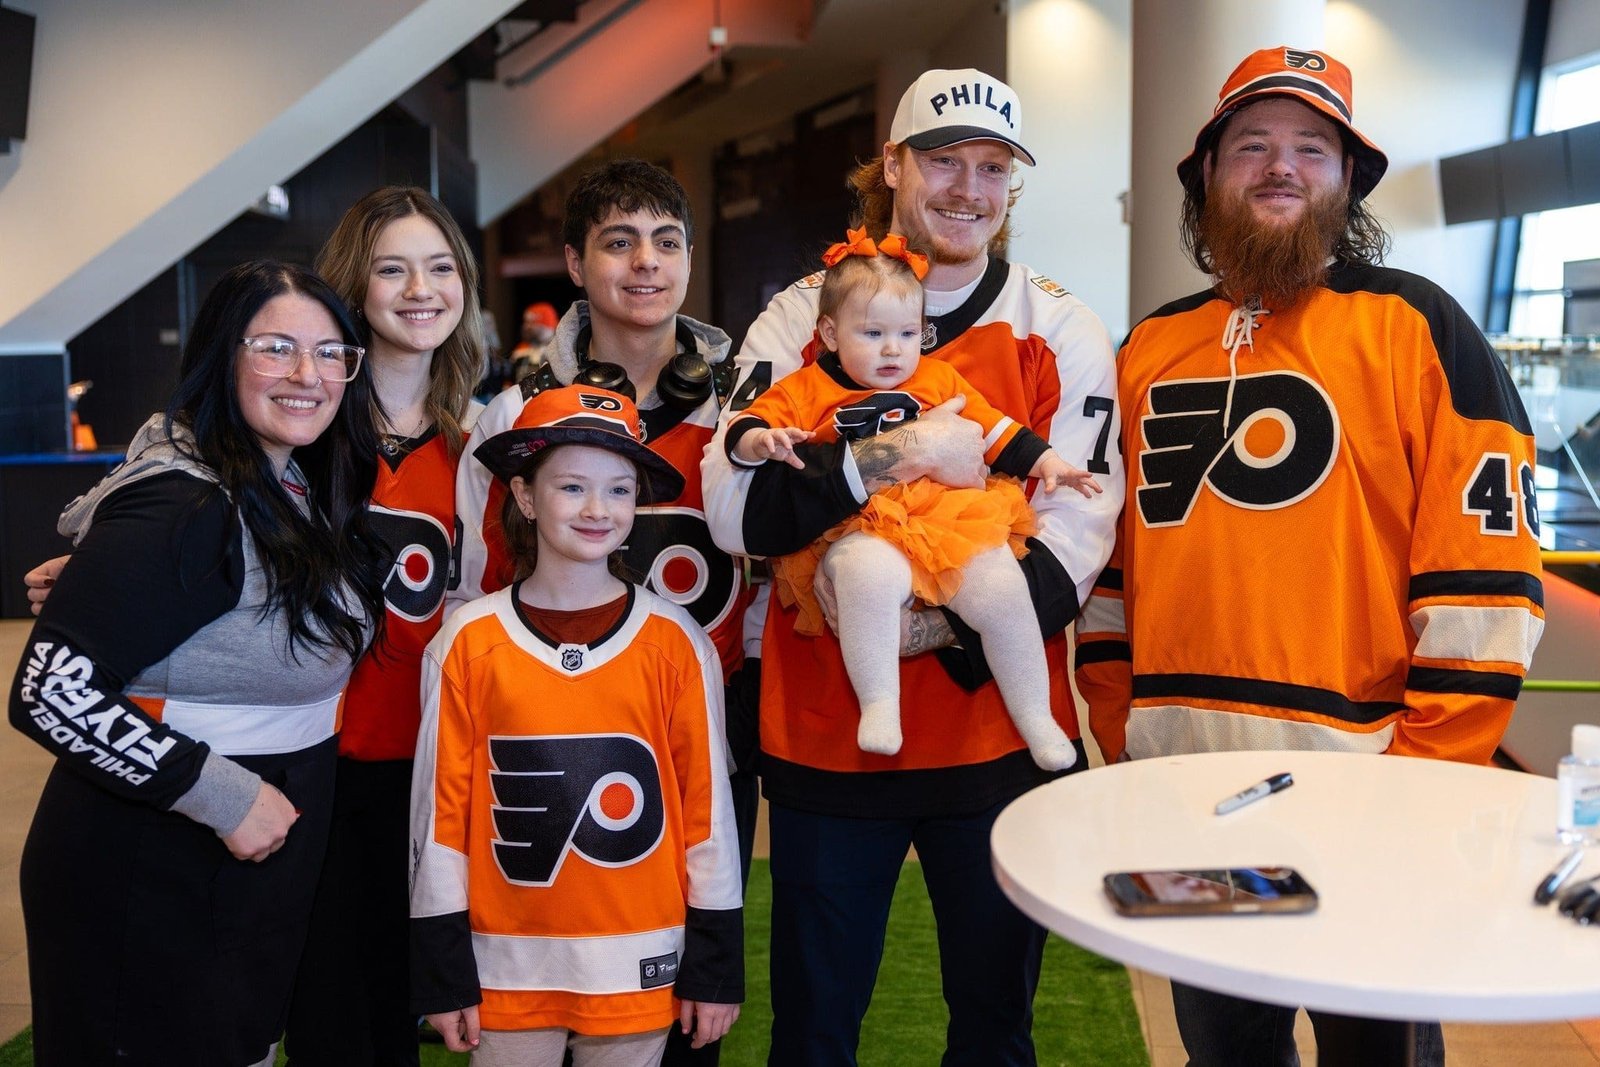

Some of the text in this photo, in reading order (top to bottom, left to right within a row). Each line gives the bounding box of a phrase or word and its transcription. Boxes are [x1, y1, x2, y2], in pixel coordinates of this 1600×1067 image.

[930, 83, 1014, 129] PHILA.
[722, 361, 773, 411] 4
[1083, 396, 1122, 475] 7
[1462, 452, 1540, 541] 48
[21, 641, 152, 785] PHILADELPHIA
[40, 646, 177, 771] FLYERS
